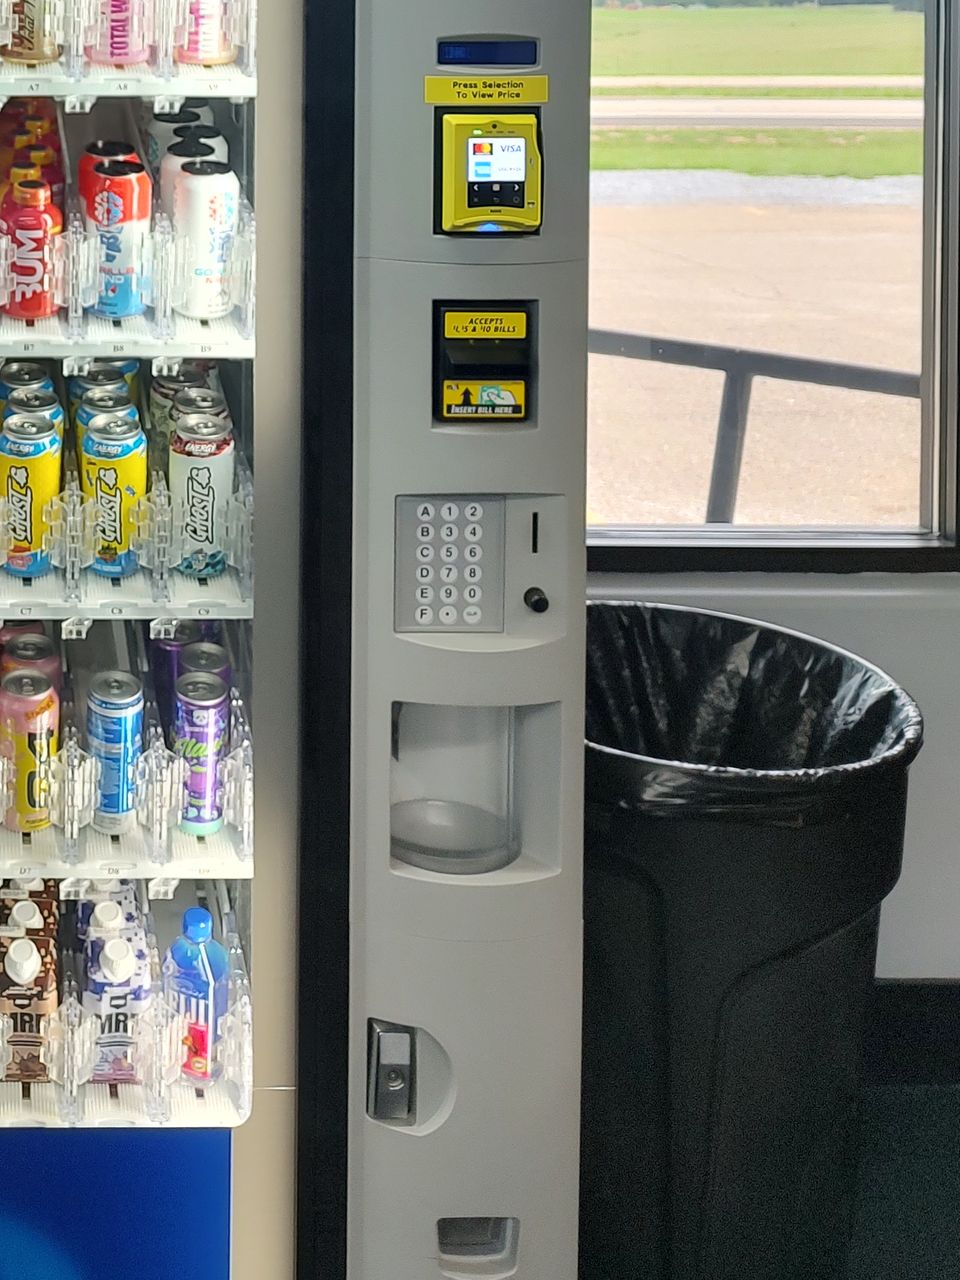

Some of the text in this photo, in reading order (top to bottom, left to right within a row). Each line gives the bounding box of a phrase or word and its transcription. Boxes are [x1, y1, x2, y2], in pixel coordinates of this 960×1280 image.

[110, 16, 129, 59] TOTAL
[452, 80, 524, 89] Press Selection
[472, 91, 494, 99] View
[497, 91, 521, 99] Price
[500, 144, 522, 153] VISA
[468, 317, 505, 325] ACCEPTS
[471, 325, 477, 333] &
[494, 325, 517, 333] BILLS
[477, 406, 493, 414] BILL
[494, 406, 514, 414] HERE
[185, 442, 216, 453] ENERGY
[6, 475, 33, 545] GHOST
[94, 477, 123, 545] GHOST
[185, 476, 216, 545] GHOST
[421, 506, 477, 517] A 1 2
[421, 527, 477, 537] B 3 4
[420, 547, 477, 558] C 5 6
[420, 567, 476, 578] D 7 8
[420, 588, 476, 598] E 9 0
[420, 608, 428, 619] F
